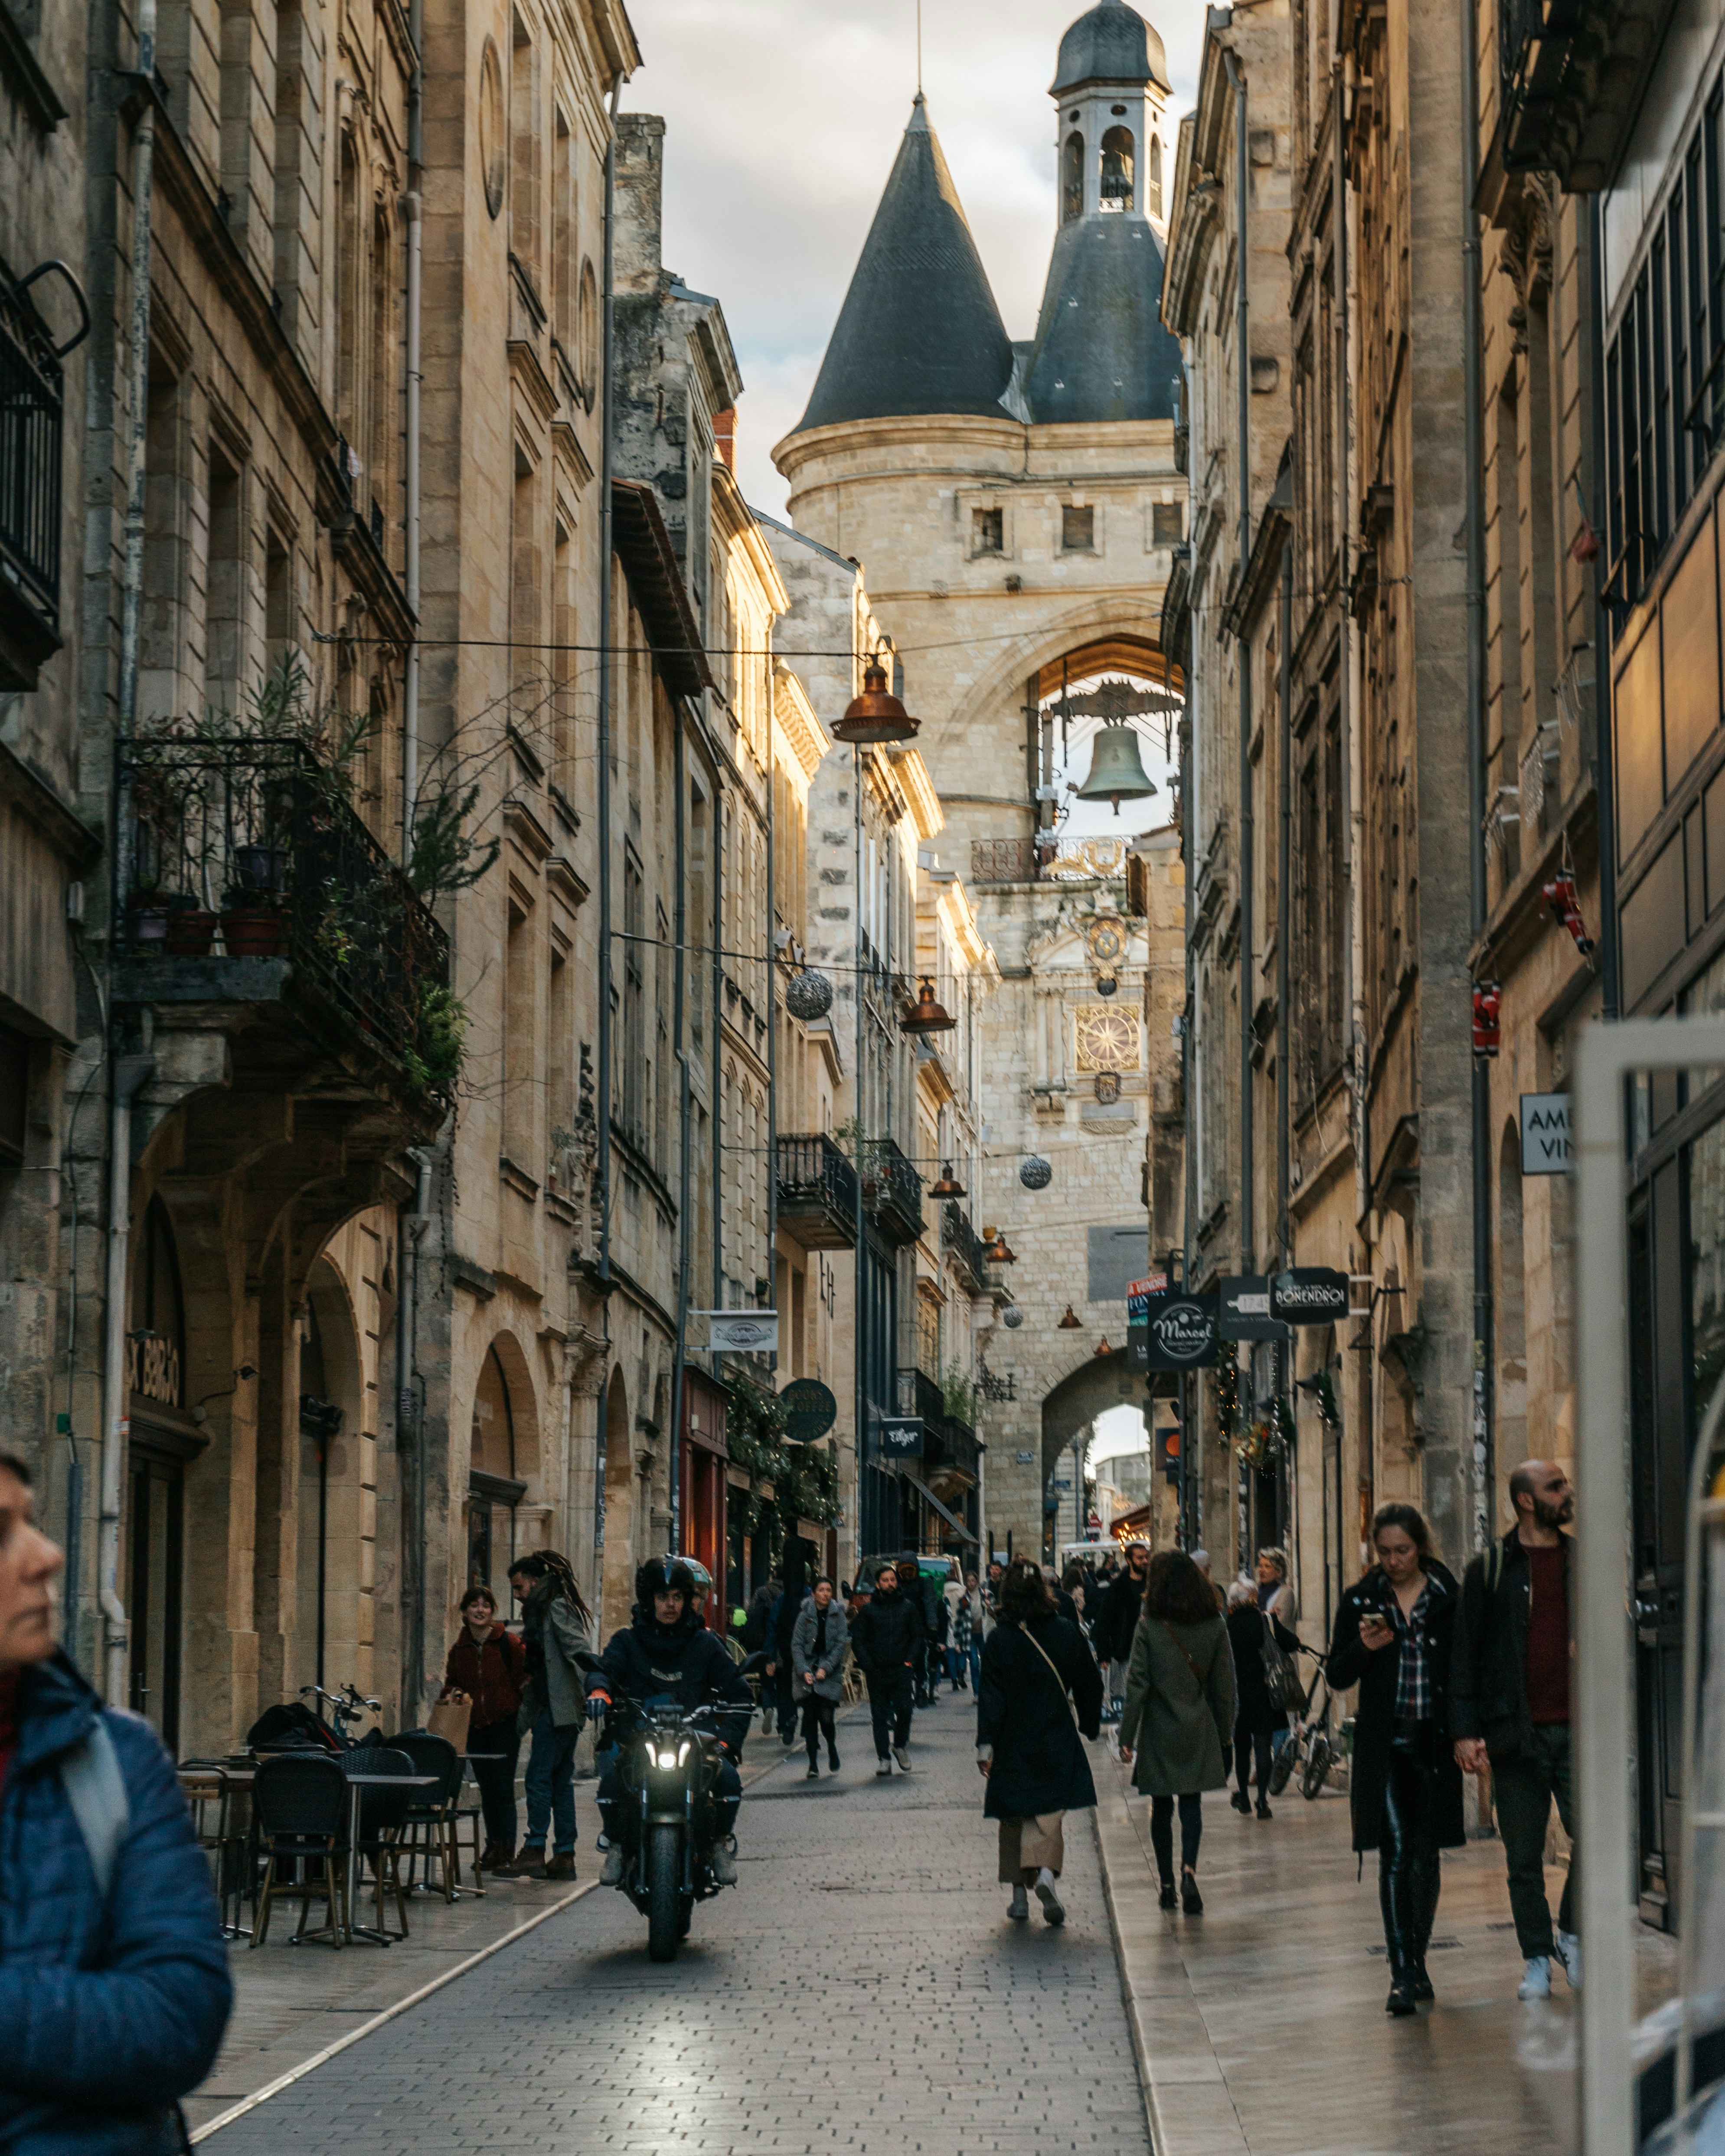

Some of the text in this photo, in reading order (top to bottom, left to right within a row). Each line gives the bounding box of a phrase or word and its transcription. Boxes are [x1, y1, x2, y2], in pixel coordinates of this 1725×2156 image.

[1528, 1109, 1571, 1131] AM
[1152, 1319, 1212, 1339] Marcel
[793, 1401, 831, 1412] OFFEE
